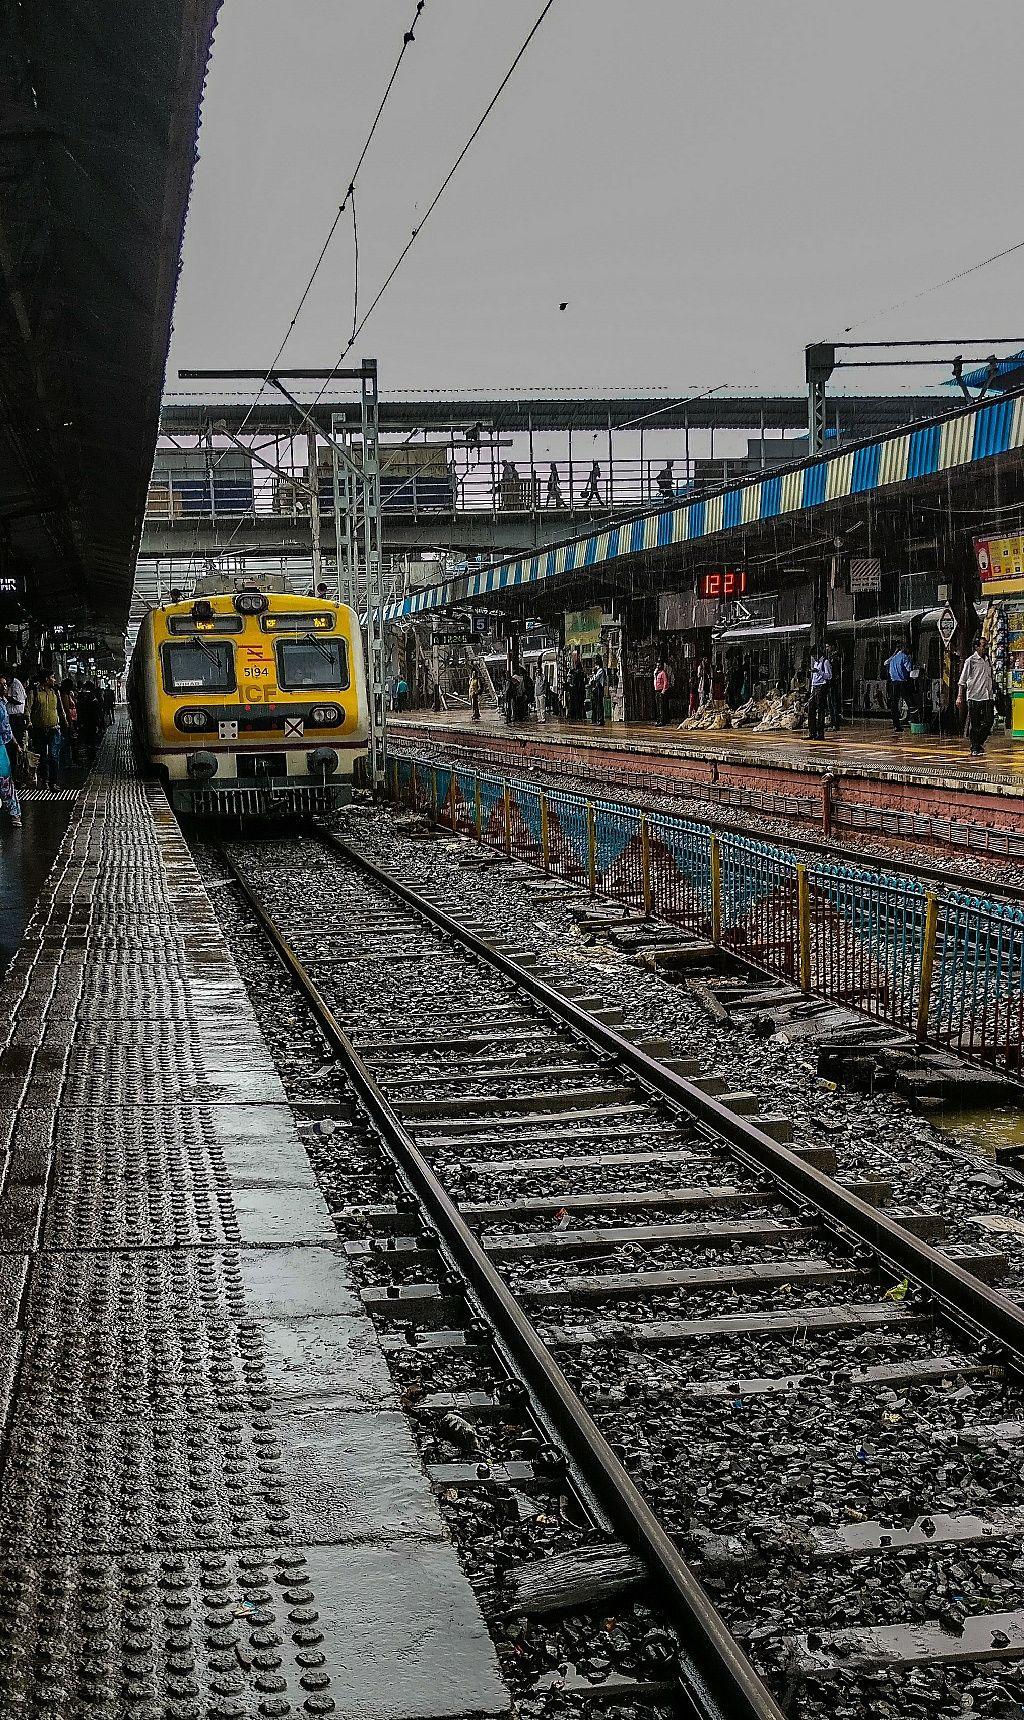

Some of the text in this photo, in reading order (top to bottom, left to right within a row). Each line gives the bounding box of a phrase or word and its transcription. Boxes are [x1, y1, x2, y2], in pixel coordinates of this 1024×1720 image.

[705, 572, 746, 594] 1221
[476, 618, 487, 631] 5
[243, 667, 270, 678] 5194
[236, 684, 278, 703] ICF
